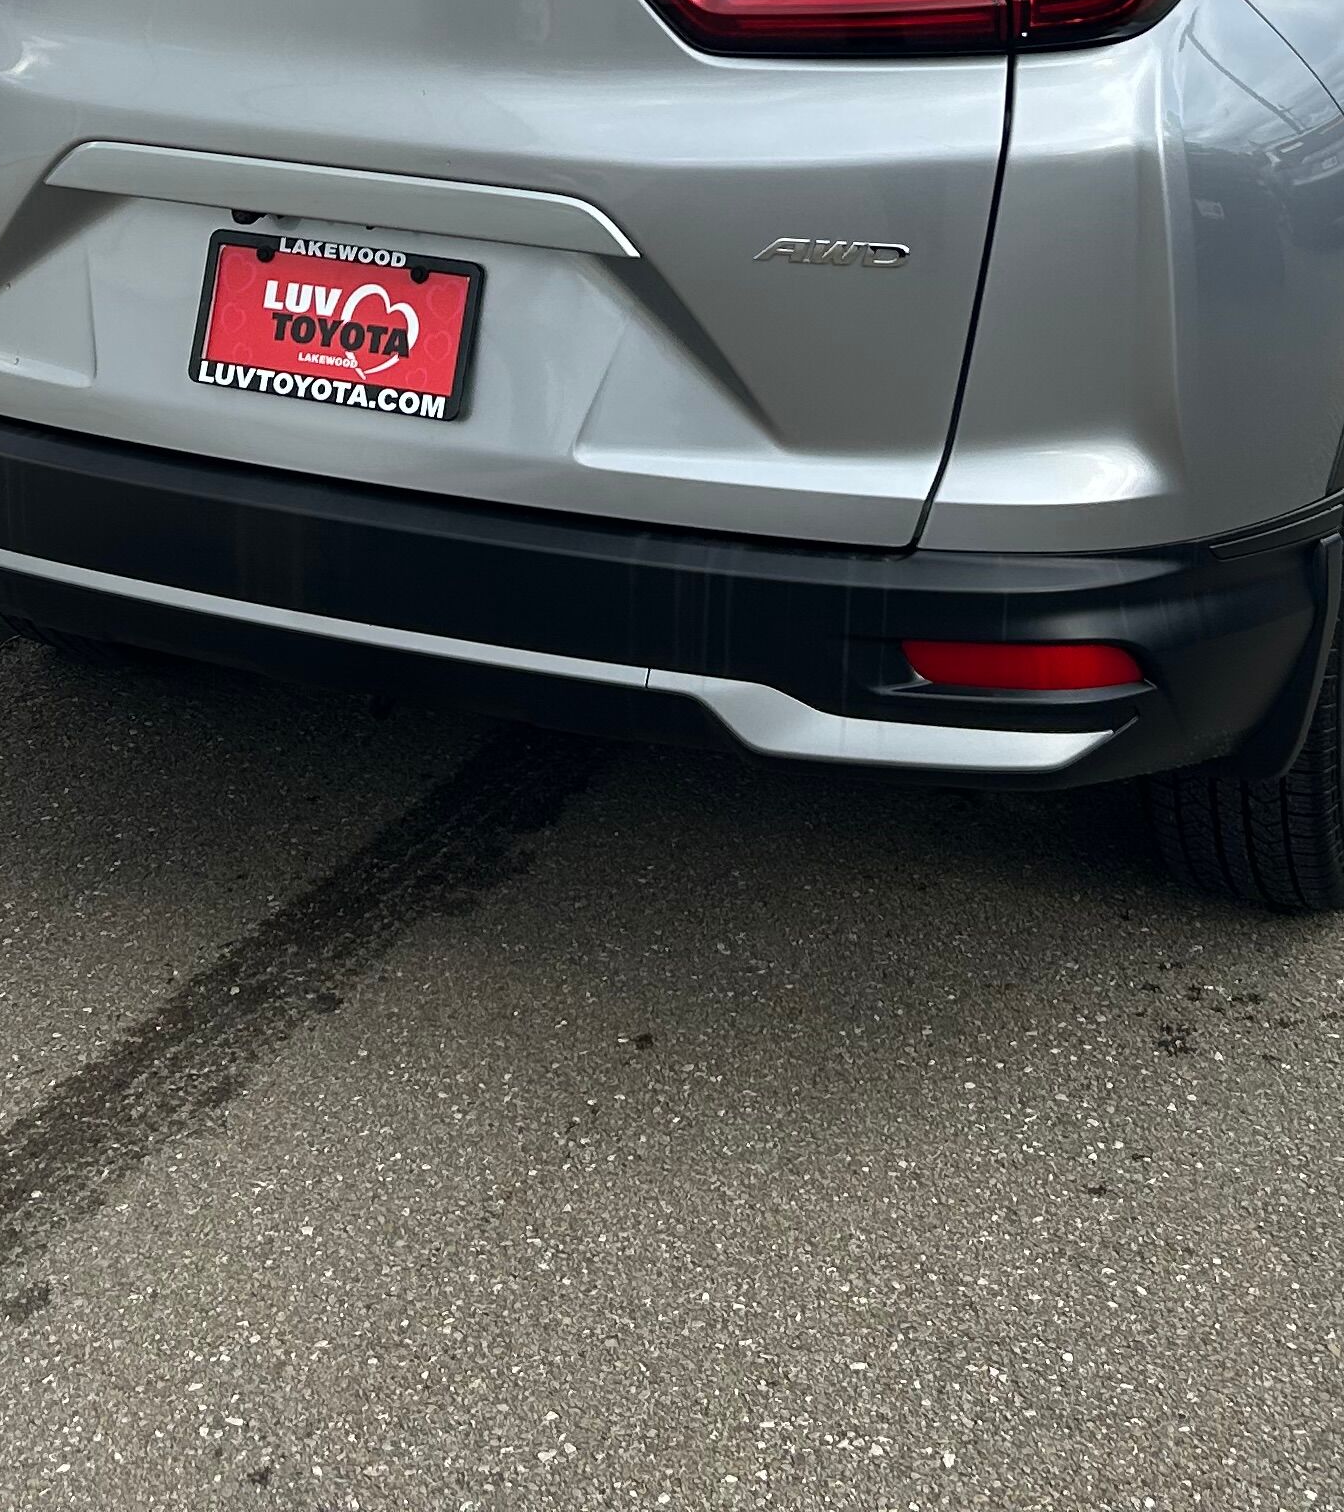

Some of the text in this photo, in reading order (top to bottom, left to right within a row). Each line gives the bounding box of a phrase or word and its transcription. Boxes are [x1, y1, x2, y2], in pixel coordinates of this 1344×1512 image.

[279, 237, 406, 268] LAKEWOOD
[753, 238, 911, 268] AWD
[263, 279, 343, 317] LUV
[272, 312, 410, 358] TOYOTA
[297, 352, 358, 369] LAKEWOOD
[198, 361, 446, 419] LUVTOYOTA.COM
